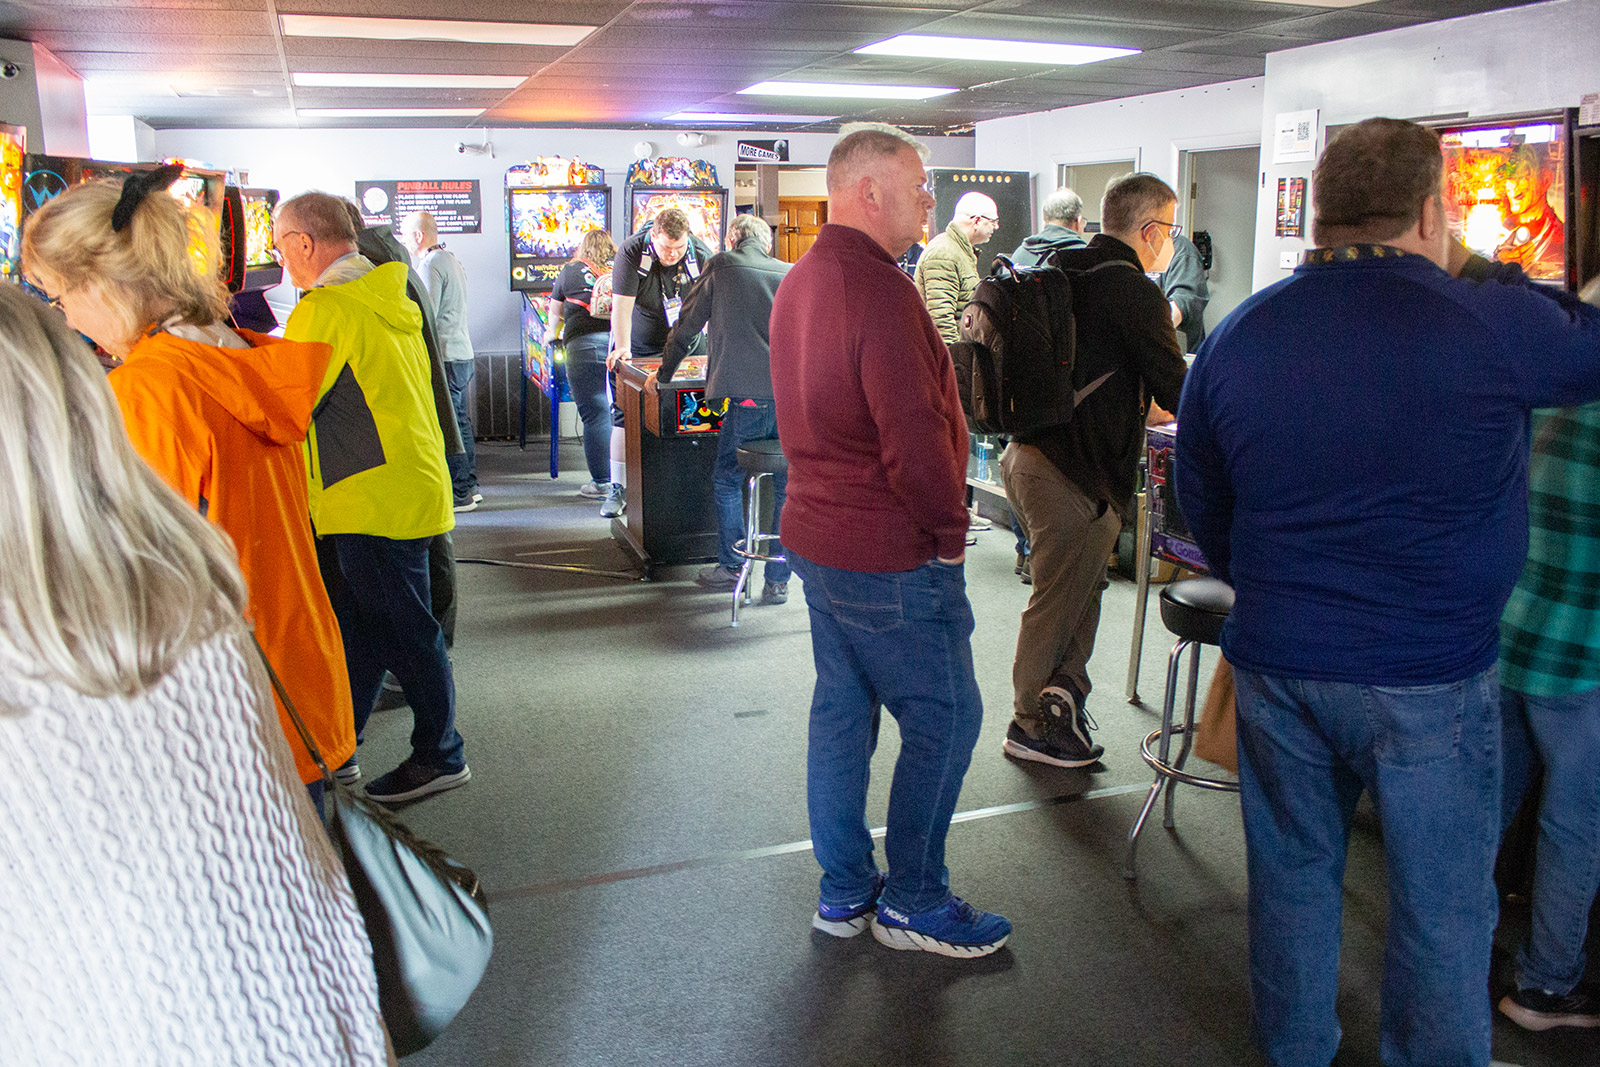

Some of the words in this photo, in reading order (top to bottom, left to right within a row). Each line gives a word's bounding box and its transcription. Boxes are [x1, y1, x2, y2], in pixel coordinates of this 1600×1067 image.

[740, 145, 757, 157] MORE
[758, 150, 779, 160] GAMES
[397, 181, 439, 190] PINBALL
[441, 181, 472, 190] RULES
[883, 906, 909, 924] HOKA
